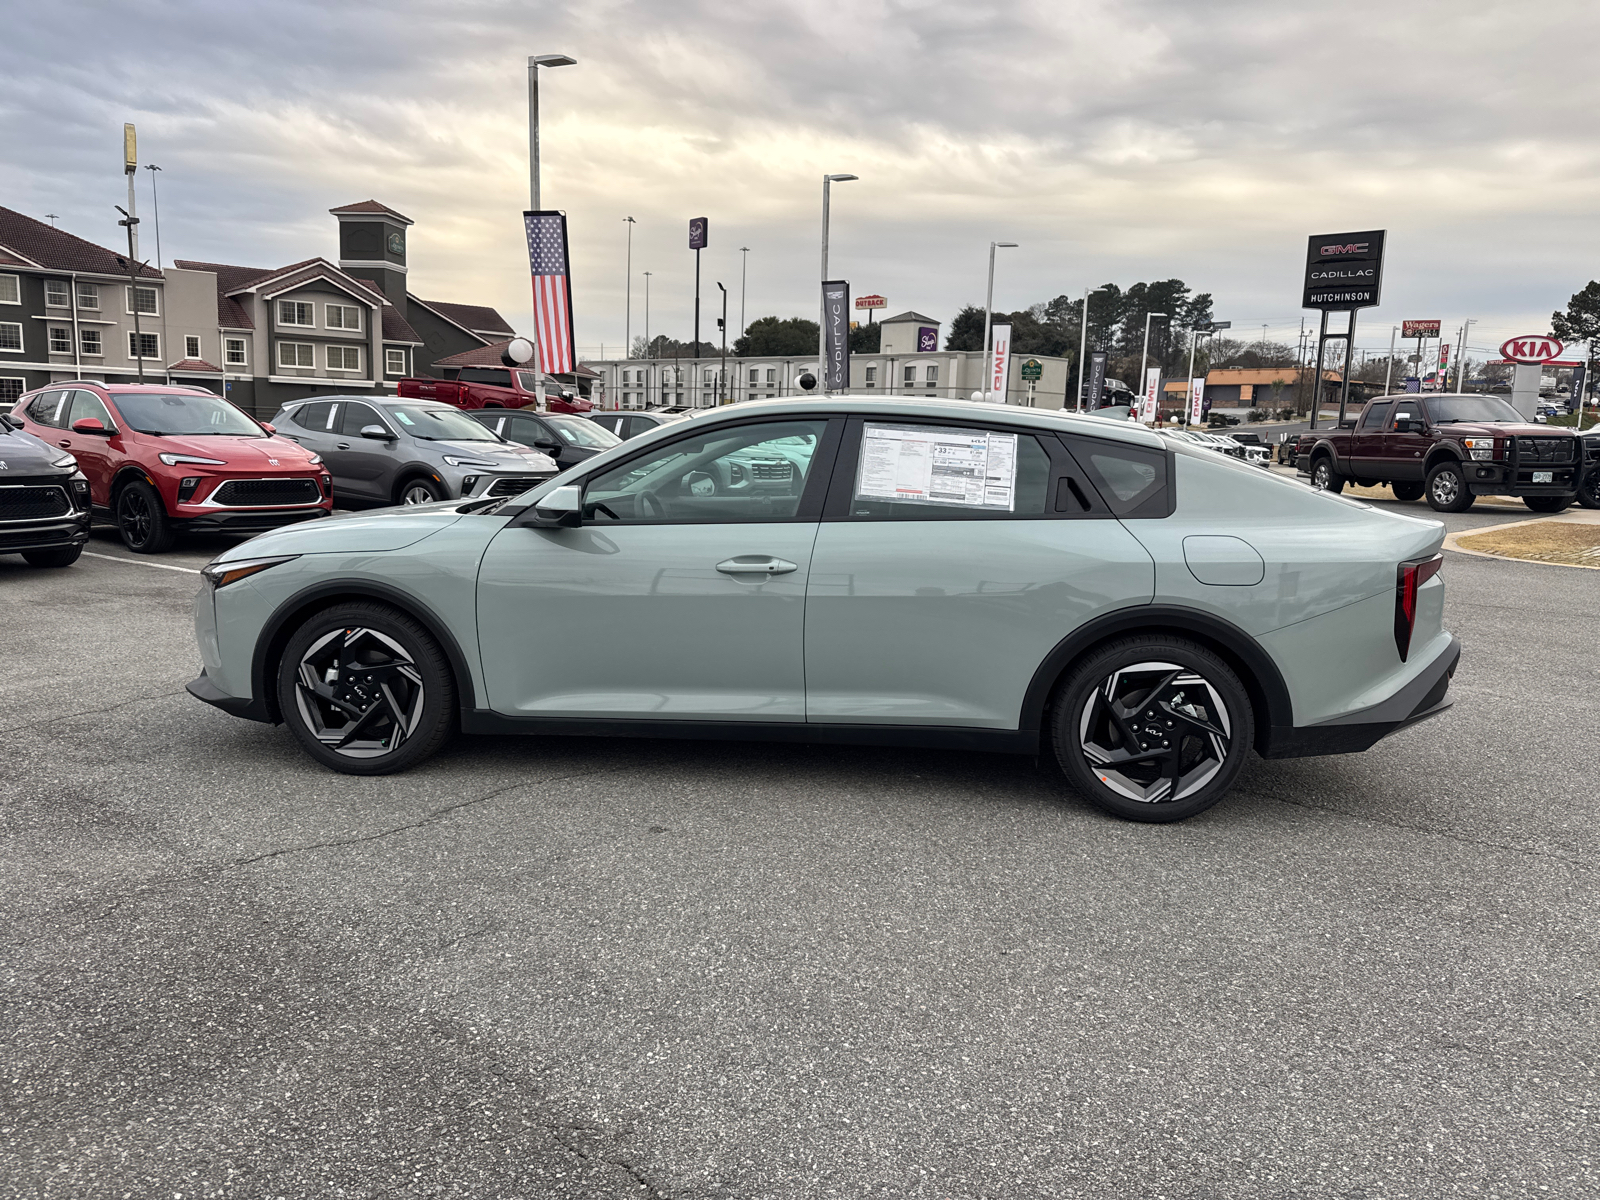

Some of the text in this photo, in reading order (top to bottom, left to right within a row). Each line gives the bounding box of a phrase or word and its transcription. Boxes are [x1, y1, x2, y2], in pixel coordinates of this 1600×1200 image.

[1321, 243, 1369, 255] GMC
[1311, 269, 1374, 279] CADILLAC
[1310, 292, 1370, 303] HUTCHINSON
[855, 299, 884, 307] OUTBACK
[1405, 321, 1438, 329] Wagers
[1512, 341, 1552, 357] KIA
